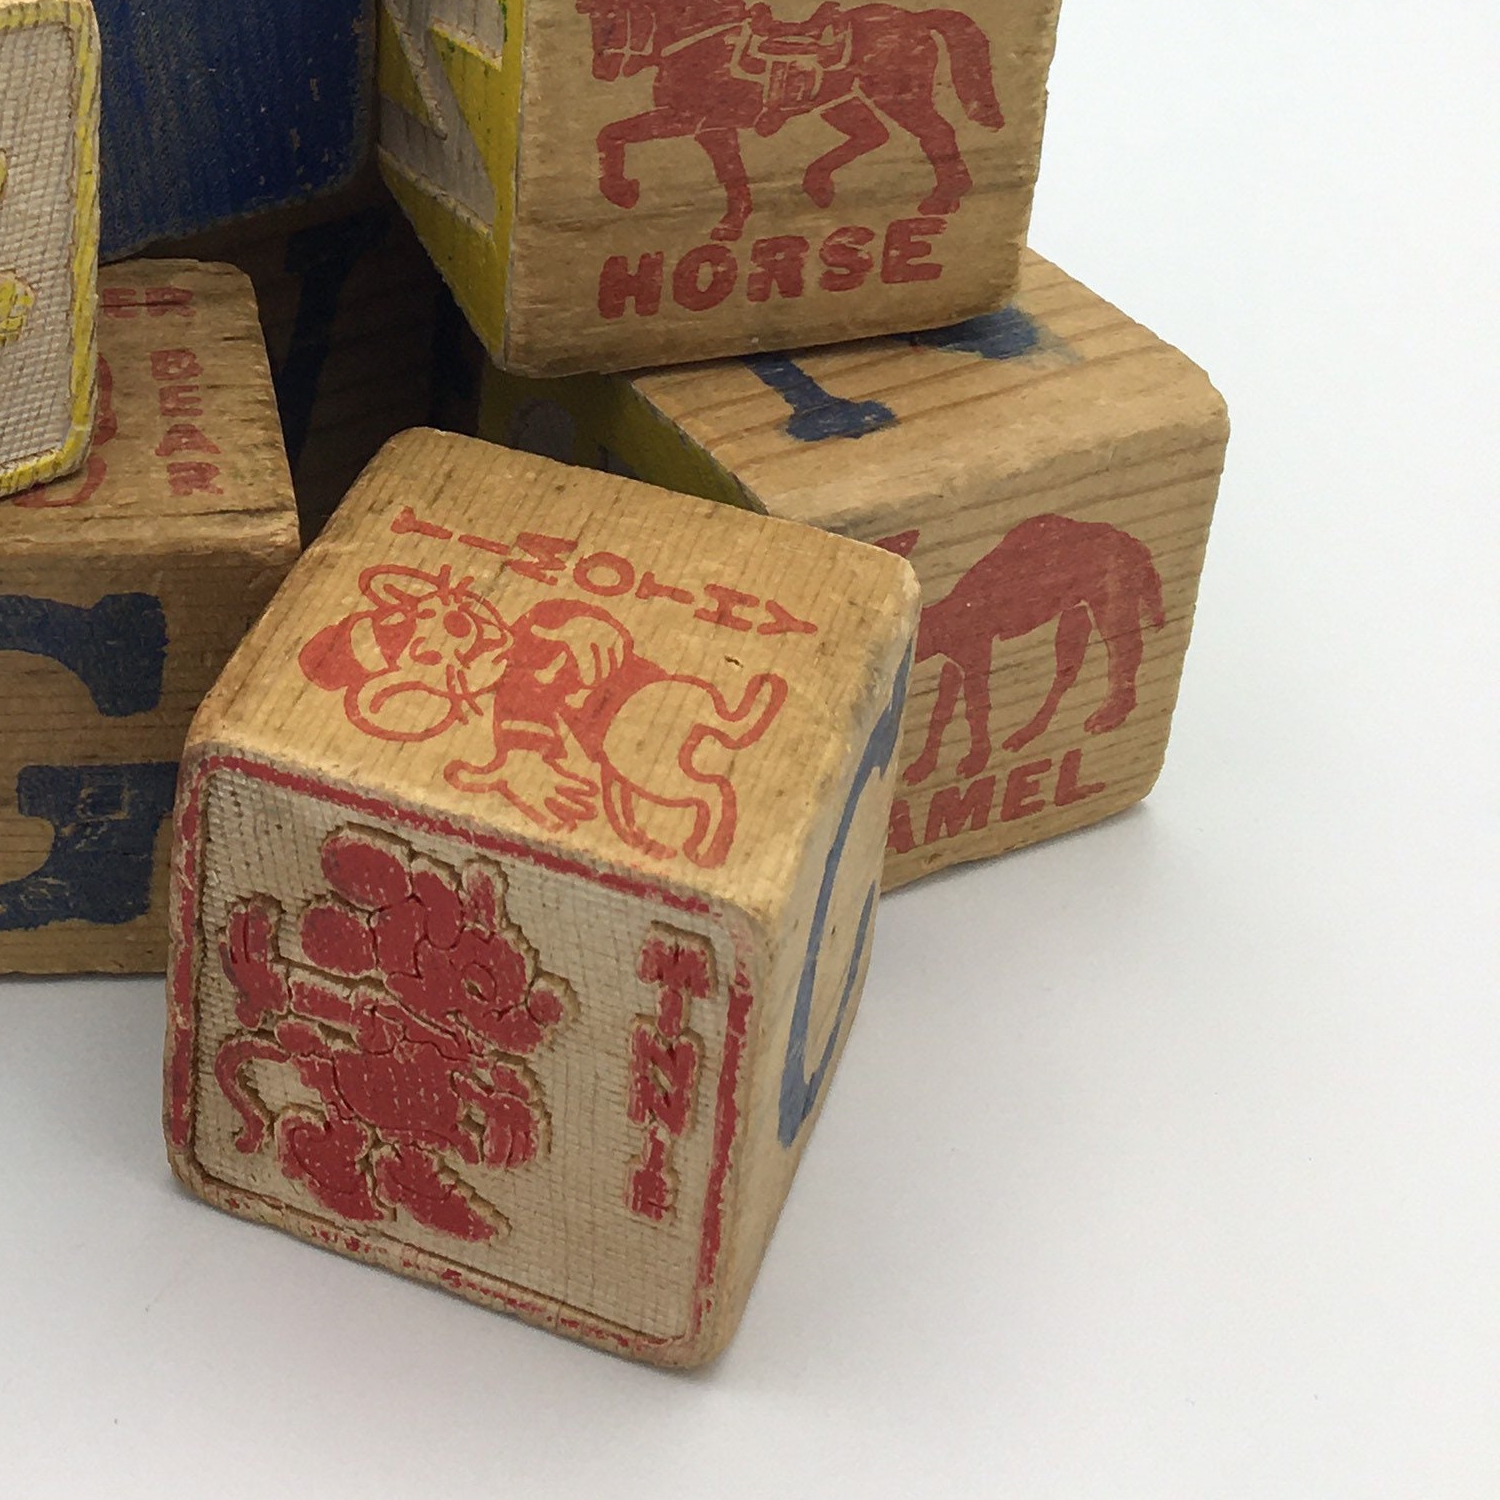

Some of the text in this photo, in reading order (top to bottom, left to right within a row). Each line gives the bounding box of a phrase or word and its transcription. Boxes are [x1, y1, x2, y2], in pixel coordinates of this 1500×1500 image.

[102, 287, 197, 319] ER
[597, 216, 948, 320] HORSE
[151, 349, 224, 497] BEAR
[390, 506, 818, 635] TIMOTHY
[886, 748, 1106, 854] AMEL
